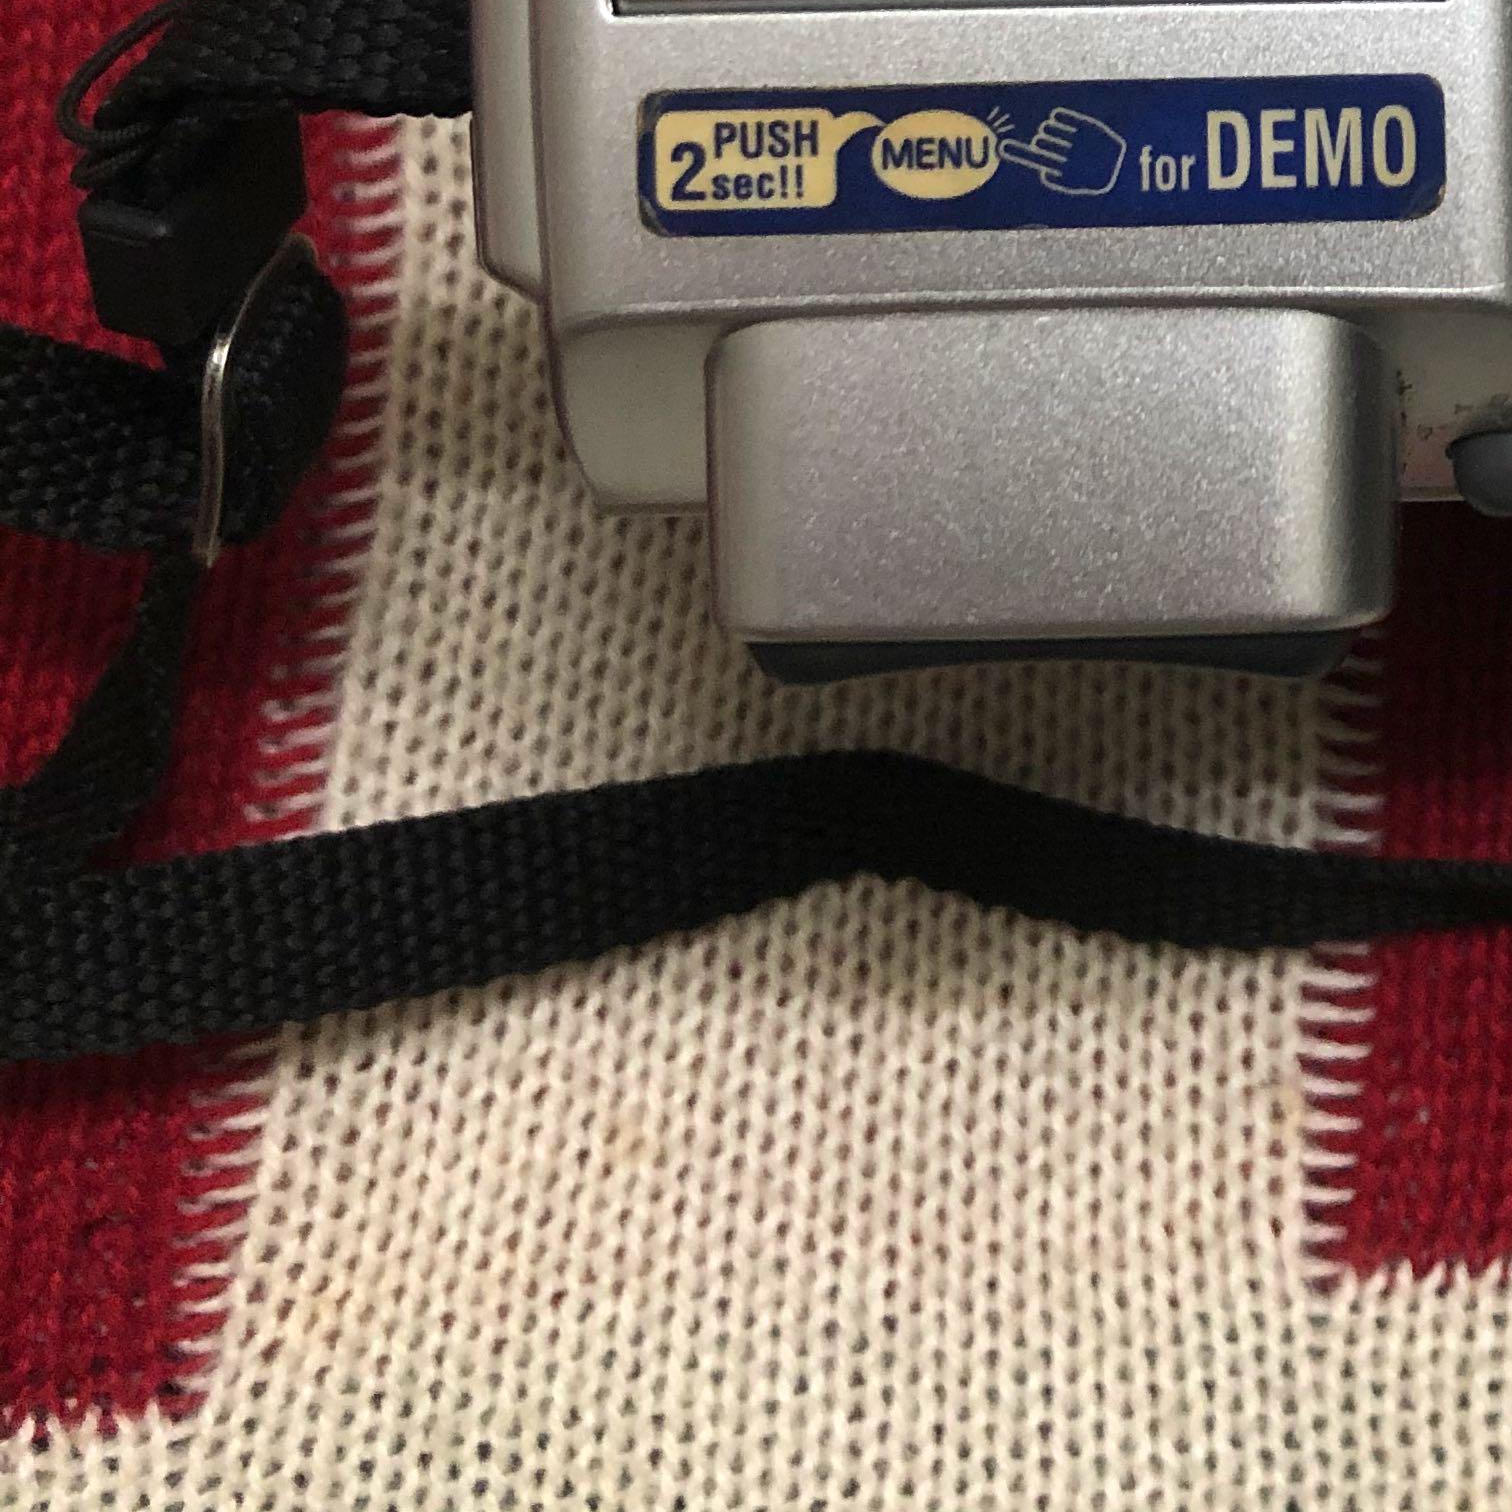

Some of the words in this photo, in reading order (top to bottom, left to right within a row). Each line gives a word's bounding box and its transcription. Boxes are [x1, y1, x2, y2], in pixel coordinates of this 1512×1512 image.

[714, 120, 820, 160] PUSH
[881, 135, 990, 171] MENU
[1139, 145, 1197, 192] for
[1206, 104, 1417, 191] DEMO
[669, 141, 706, 202] 2
[711, 165, 805, 201] sec!!
